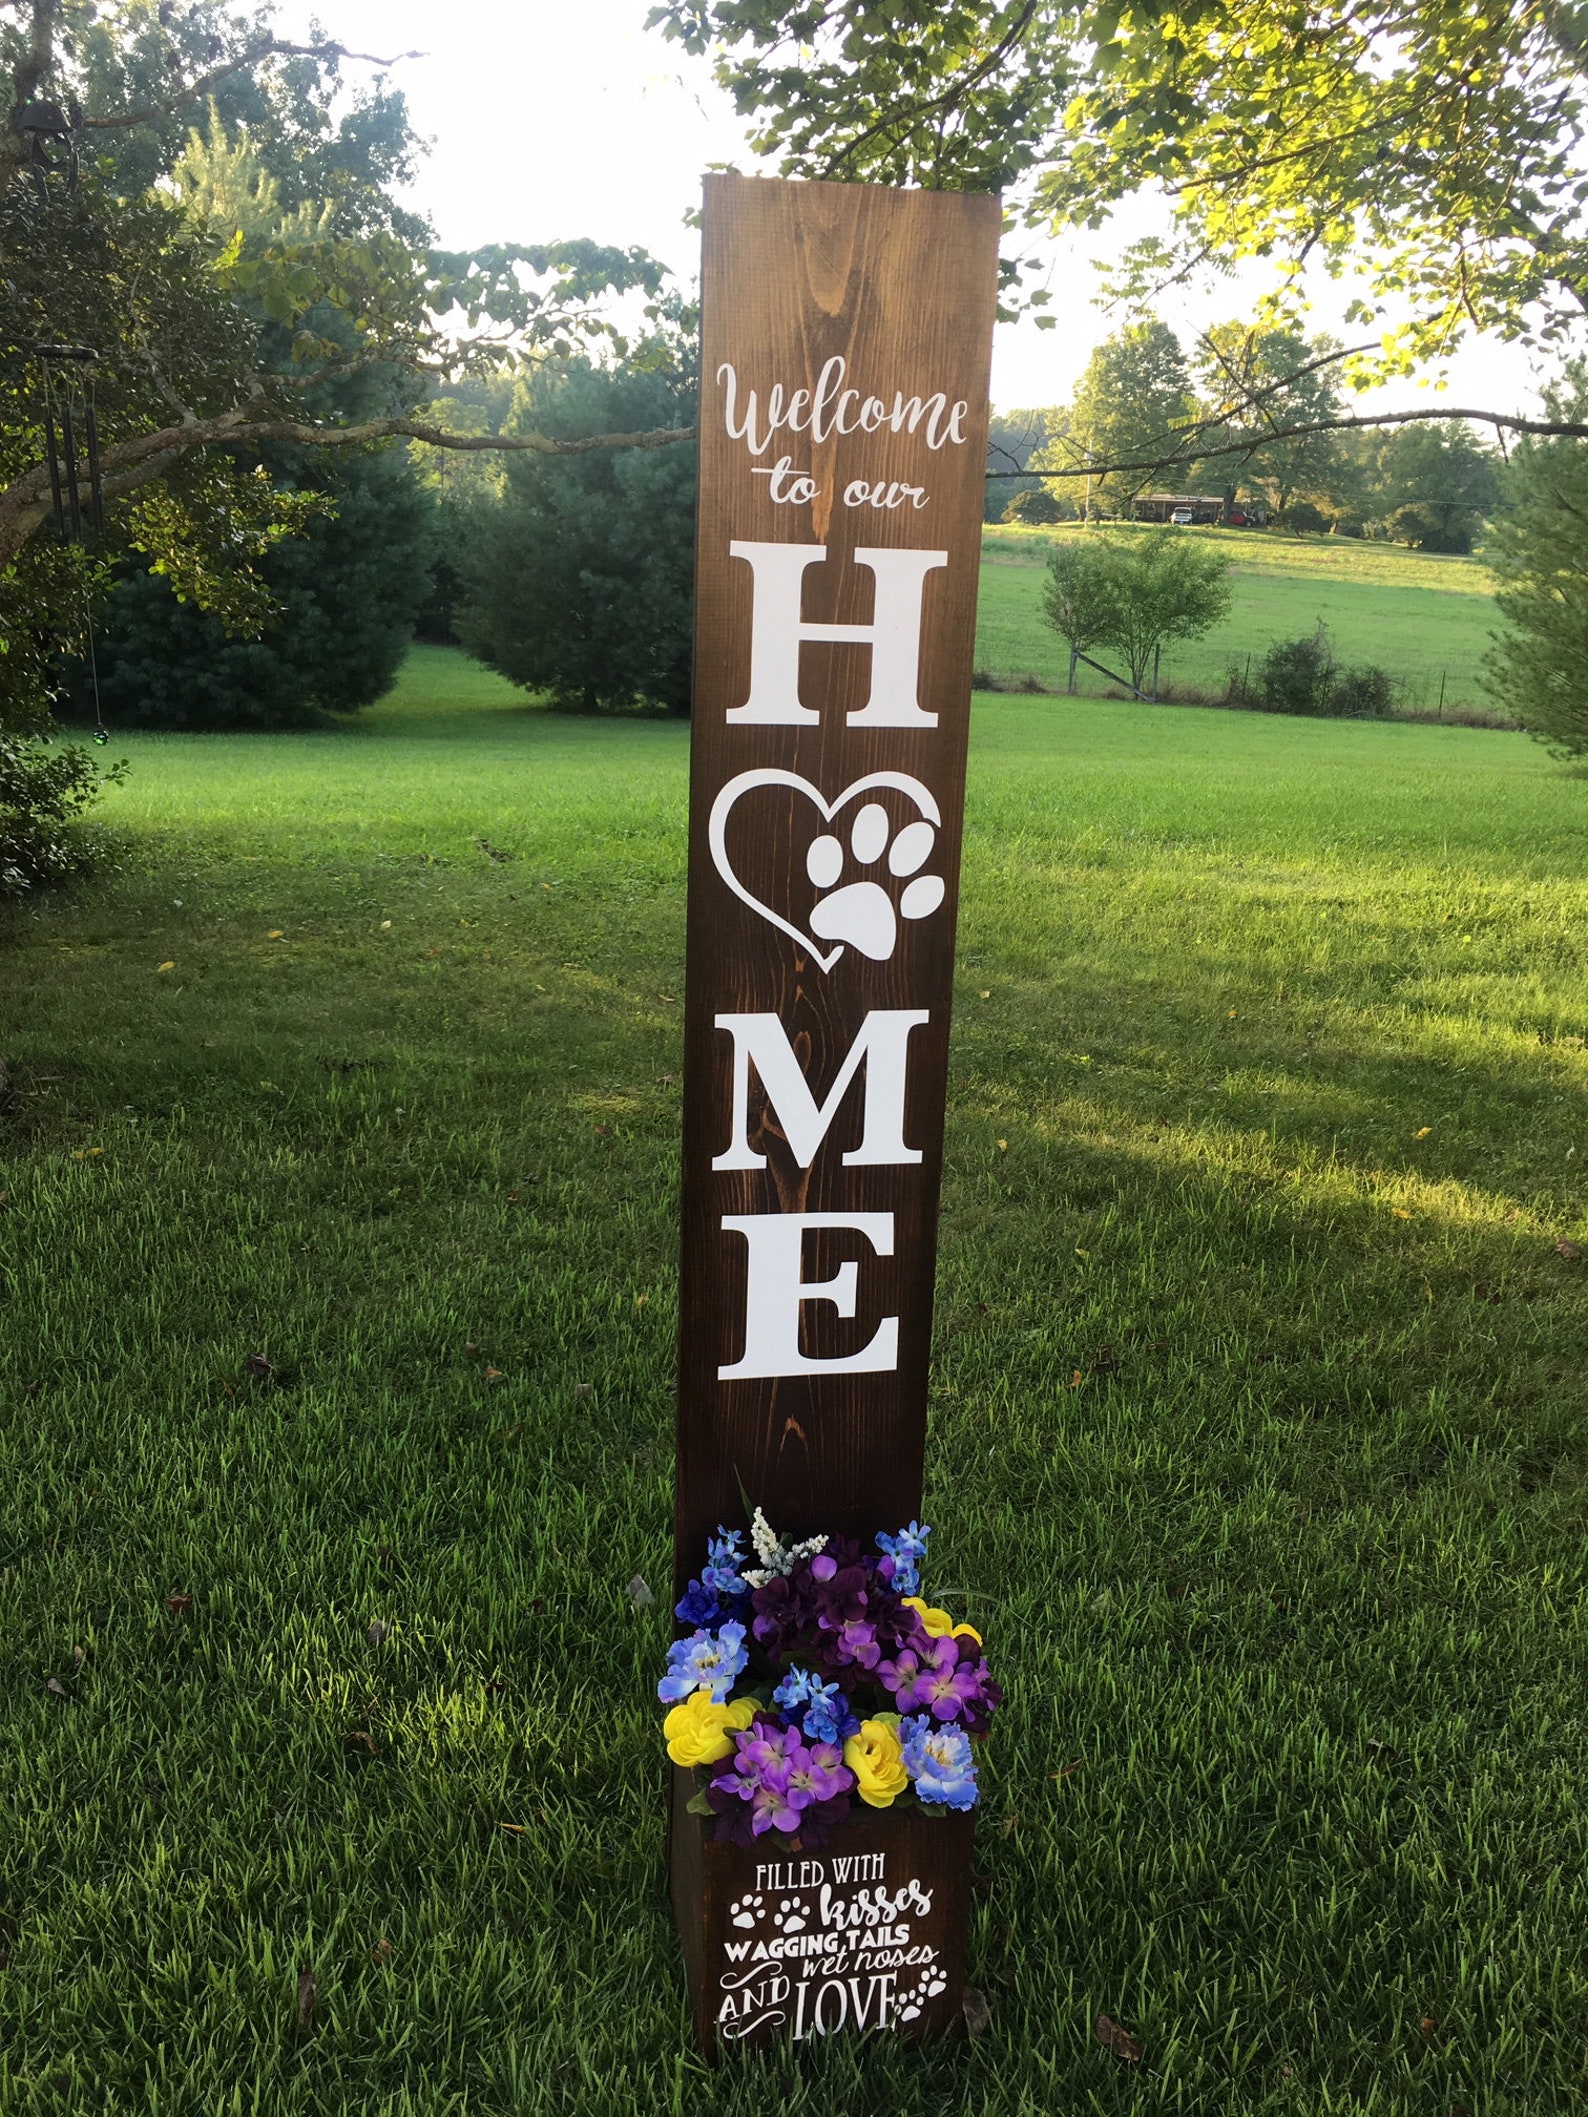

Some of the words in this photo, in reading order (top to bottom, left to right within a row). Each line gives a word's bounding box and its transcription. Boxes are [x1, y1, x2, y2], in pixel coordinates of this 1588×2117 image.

[716, 355, 968, 456] Welcome
[751, 455, 821, 505] to
[843, 479, 930, 510] our
[755, 1860, 825, 1891] FILLED
[831, 1852, 885, 1885] WITH
[820, 1878, 934, 1931] kisses
[723, 1931, 839, 1963] WAGGING
[846, 1923, 911, 1951] TAILS
[802, 1944, 850, 1978] wet
[853, 1944, 940, 1972] noses
[713, 1974, 791, 2025] AND
[792, 1970, 899, 2045] LOVE
